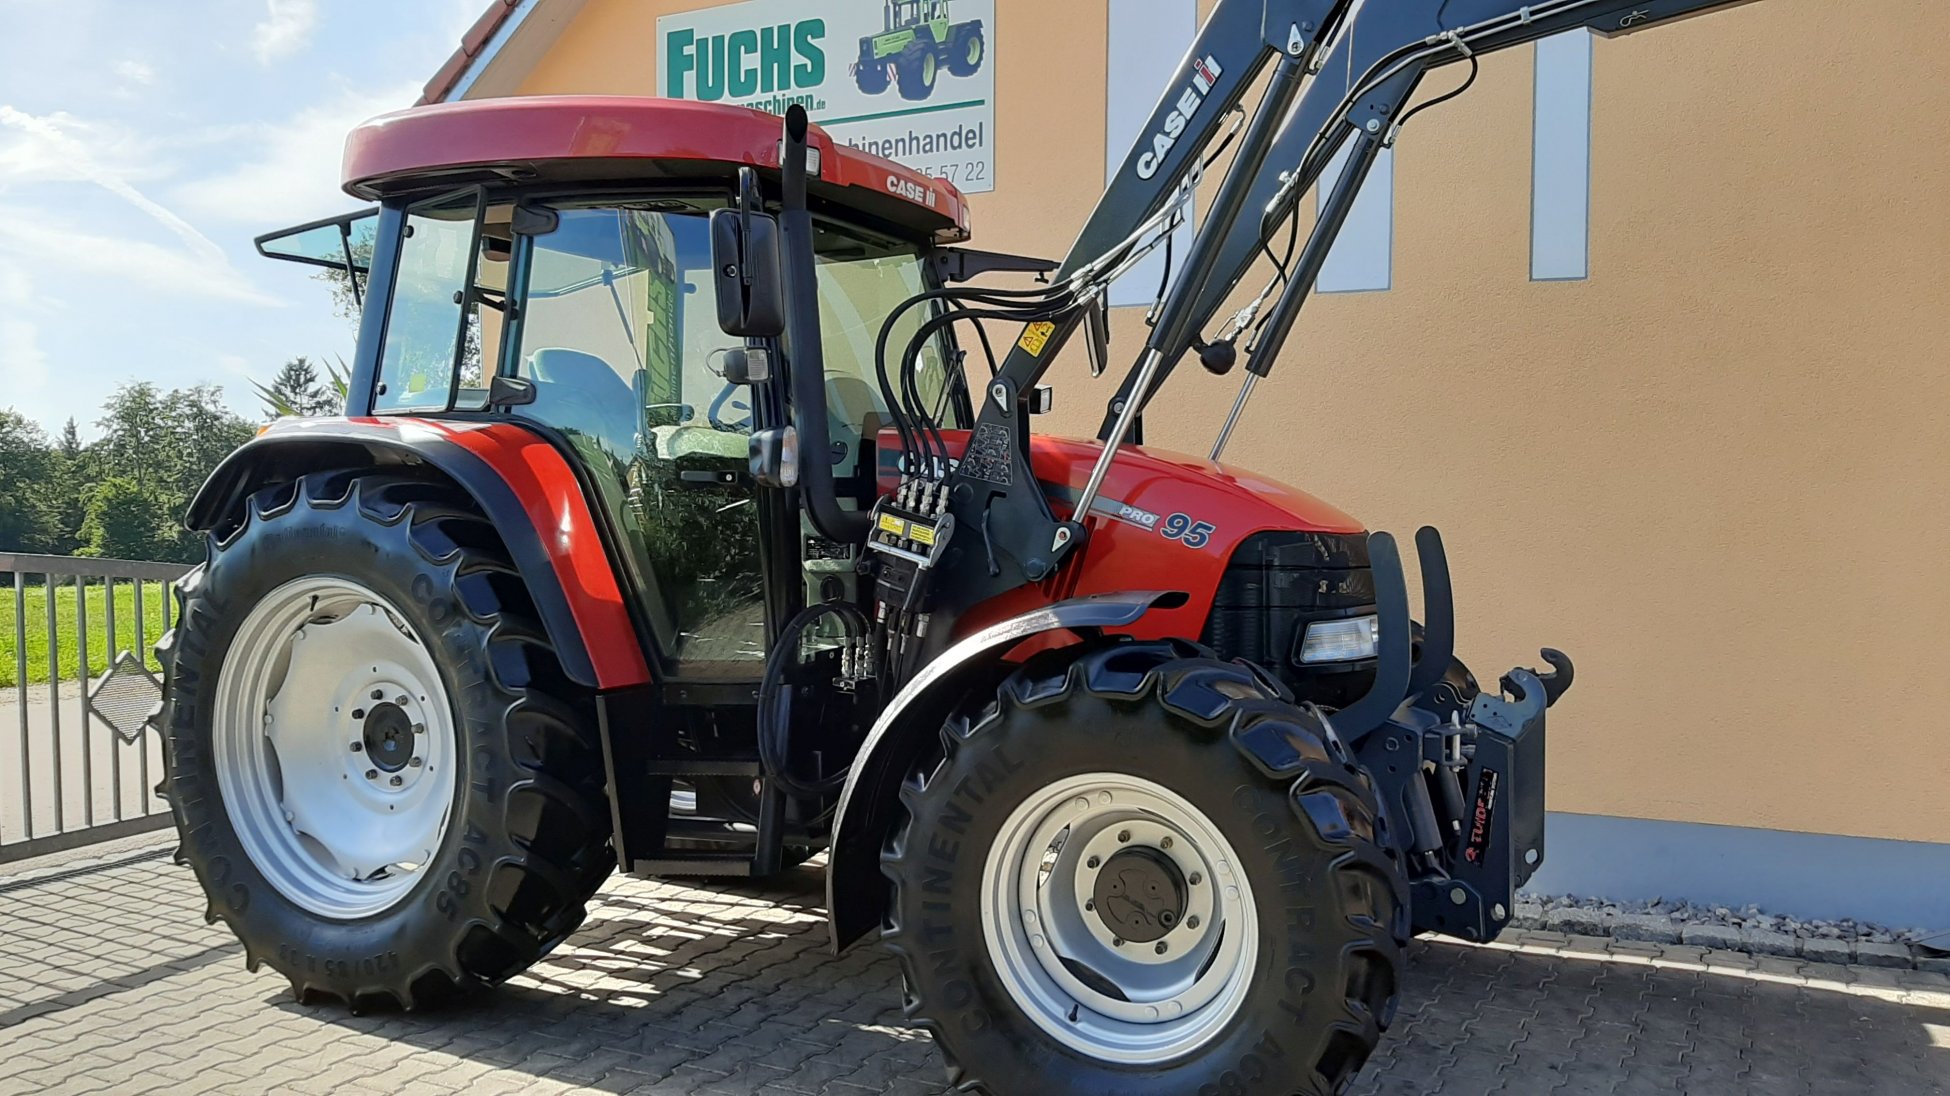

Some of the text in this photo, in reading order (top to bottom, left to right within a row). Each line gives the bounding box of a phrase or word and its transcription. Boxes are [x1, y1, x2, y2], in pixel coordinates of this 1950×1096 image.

[667, 18, 825, 101] FUCHS
[1136, 86, 1202, 181] CASE
[886, 175, 924, 203] CASE
[964, 161, 985, 181] 22
[1120, 504, 1217, 549] PRO 95
[922, 744, 1026, 1038] CONTINENTAL
